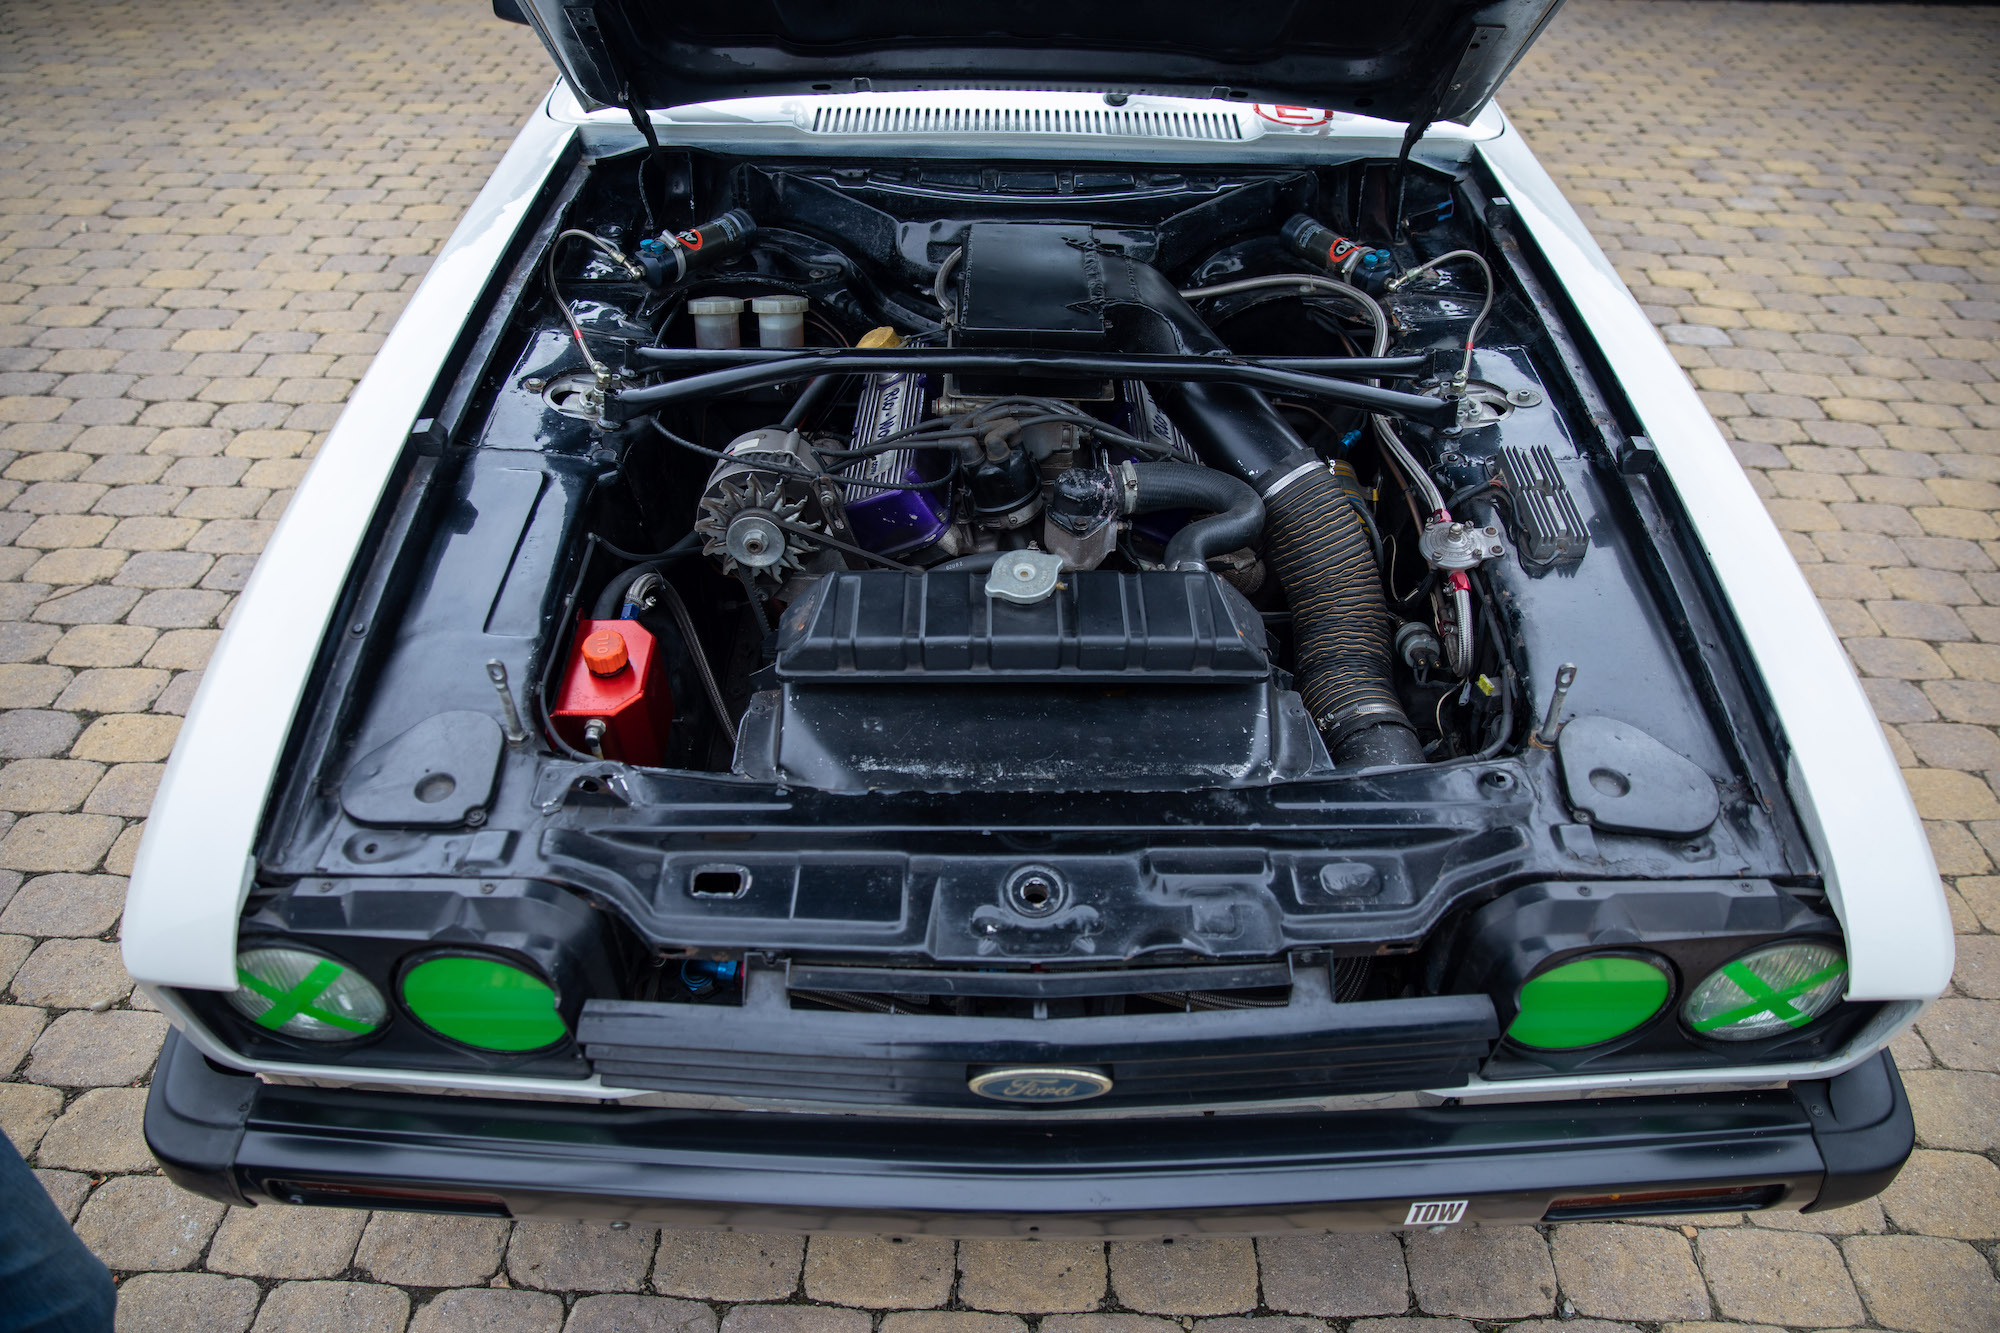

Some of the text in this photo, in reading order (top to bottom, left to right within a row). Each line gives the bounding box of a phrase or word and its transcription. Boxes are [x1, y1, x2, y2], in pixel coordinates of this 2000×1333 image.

[597, 633, 609, 654] OIL
[1003, 1079, 1078, 1096] Ford
[1411, 1202, 1464, 1223] TOW
